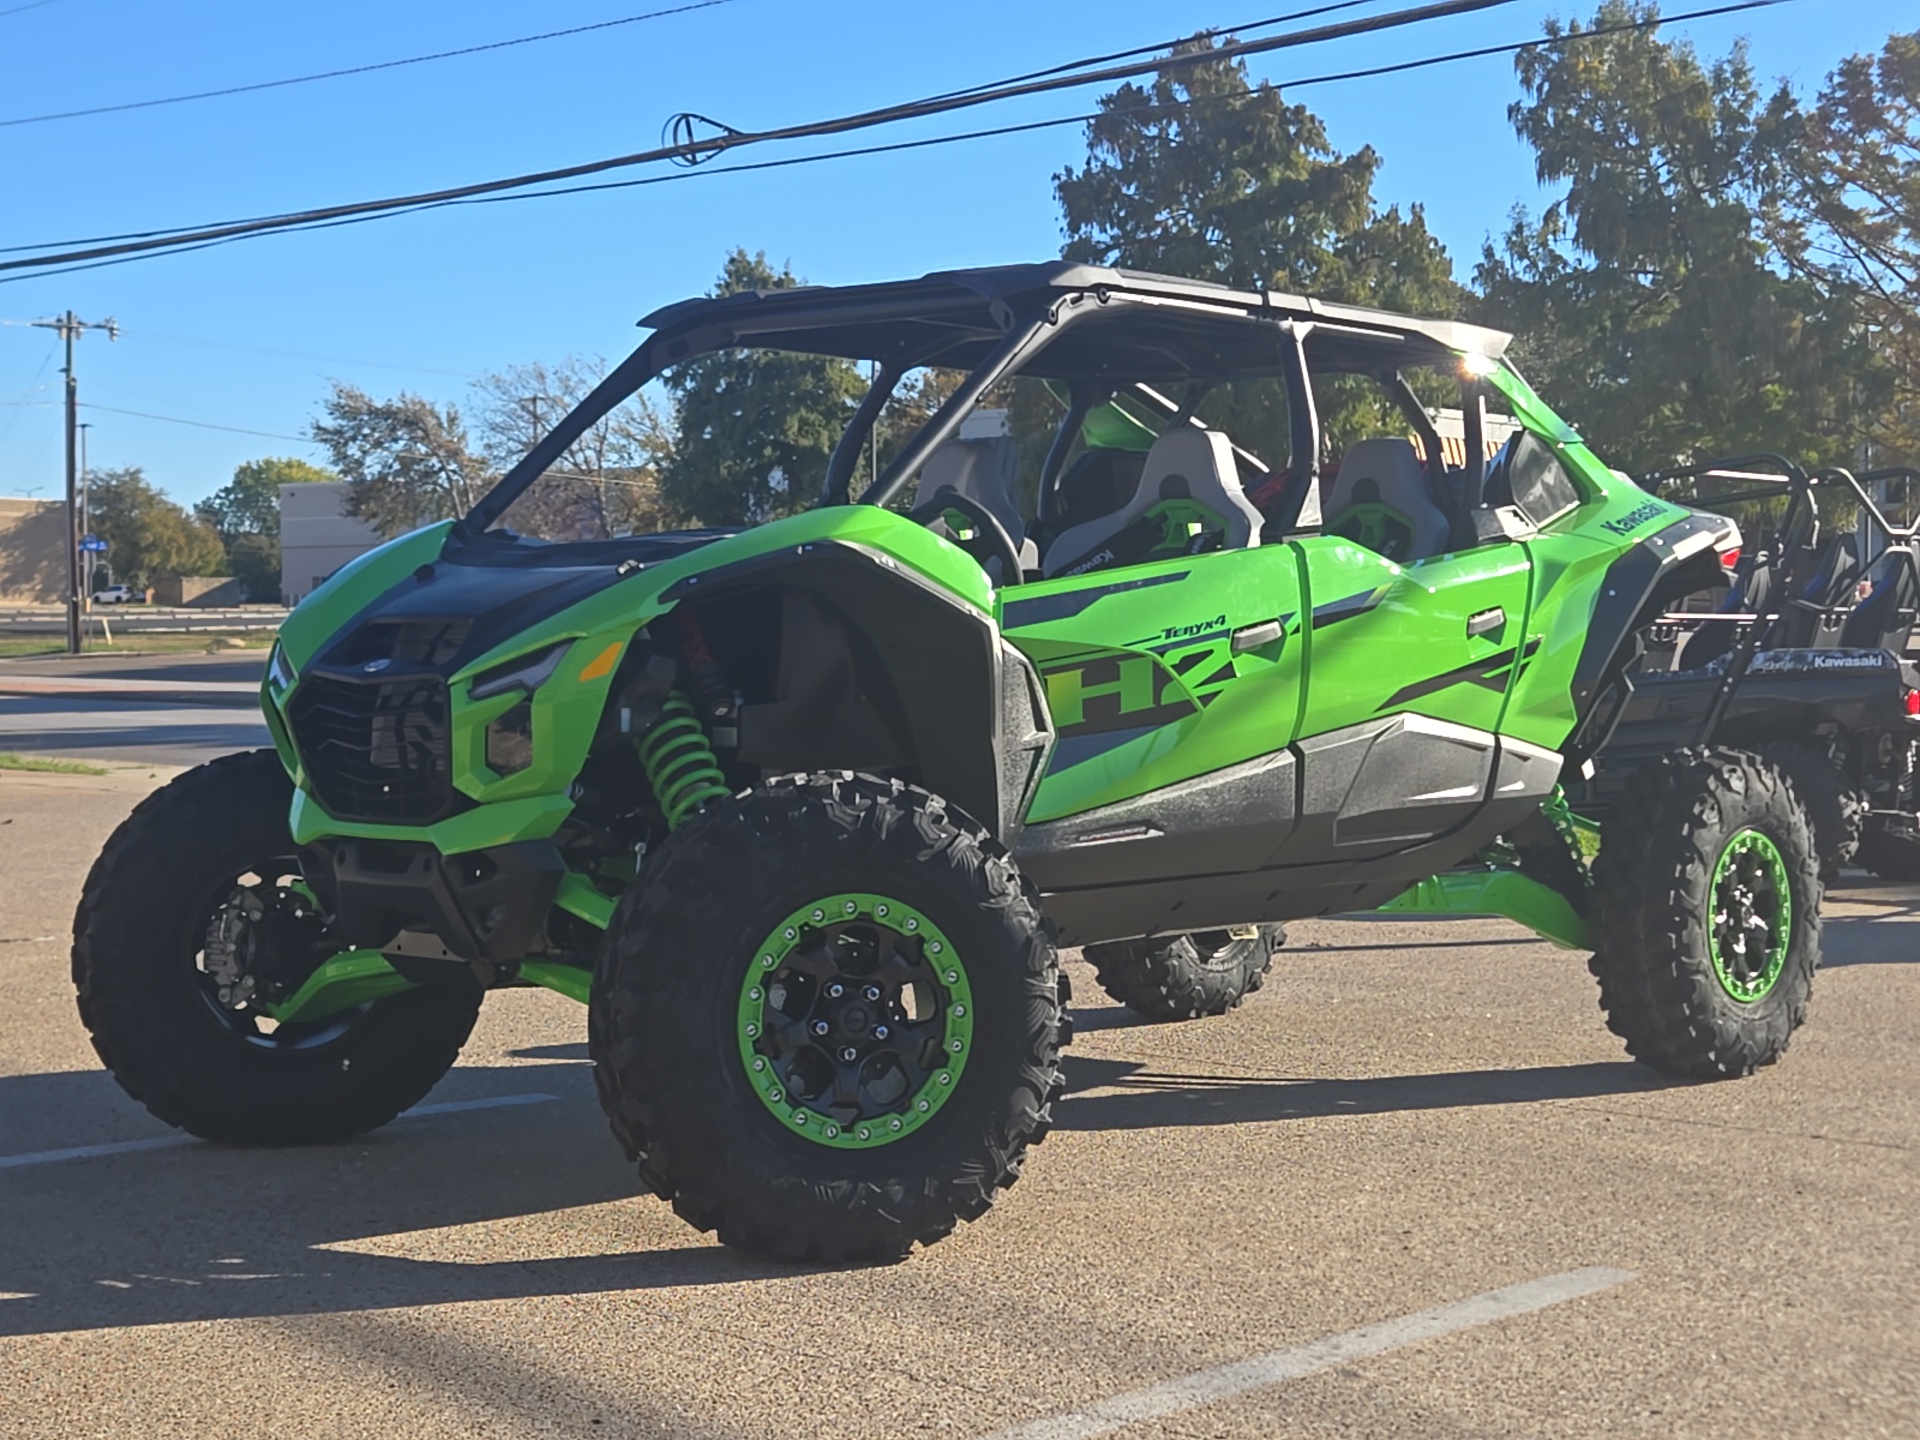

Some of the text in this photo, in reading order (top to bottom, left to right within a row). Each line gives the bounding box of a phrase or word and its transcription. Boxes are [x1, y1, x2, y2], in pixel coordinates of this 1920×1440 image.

[1600, 499, 1668, 537] Kawasaki
[1813, 654, 1883, 668] Kawasaki
[1045, 640, 1239, 727] H2
